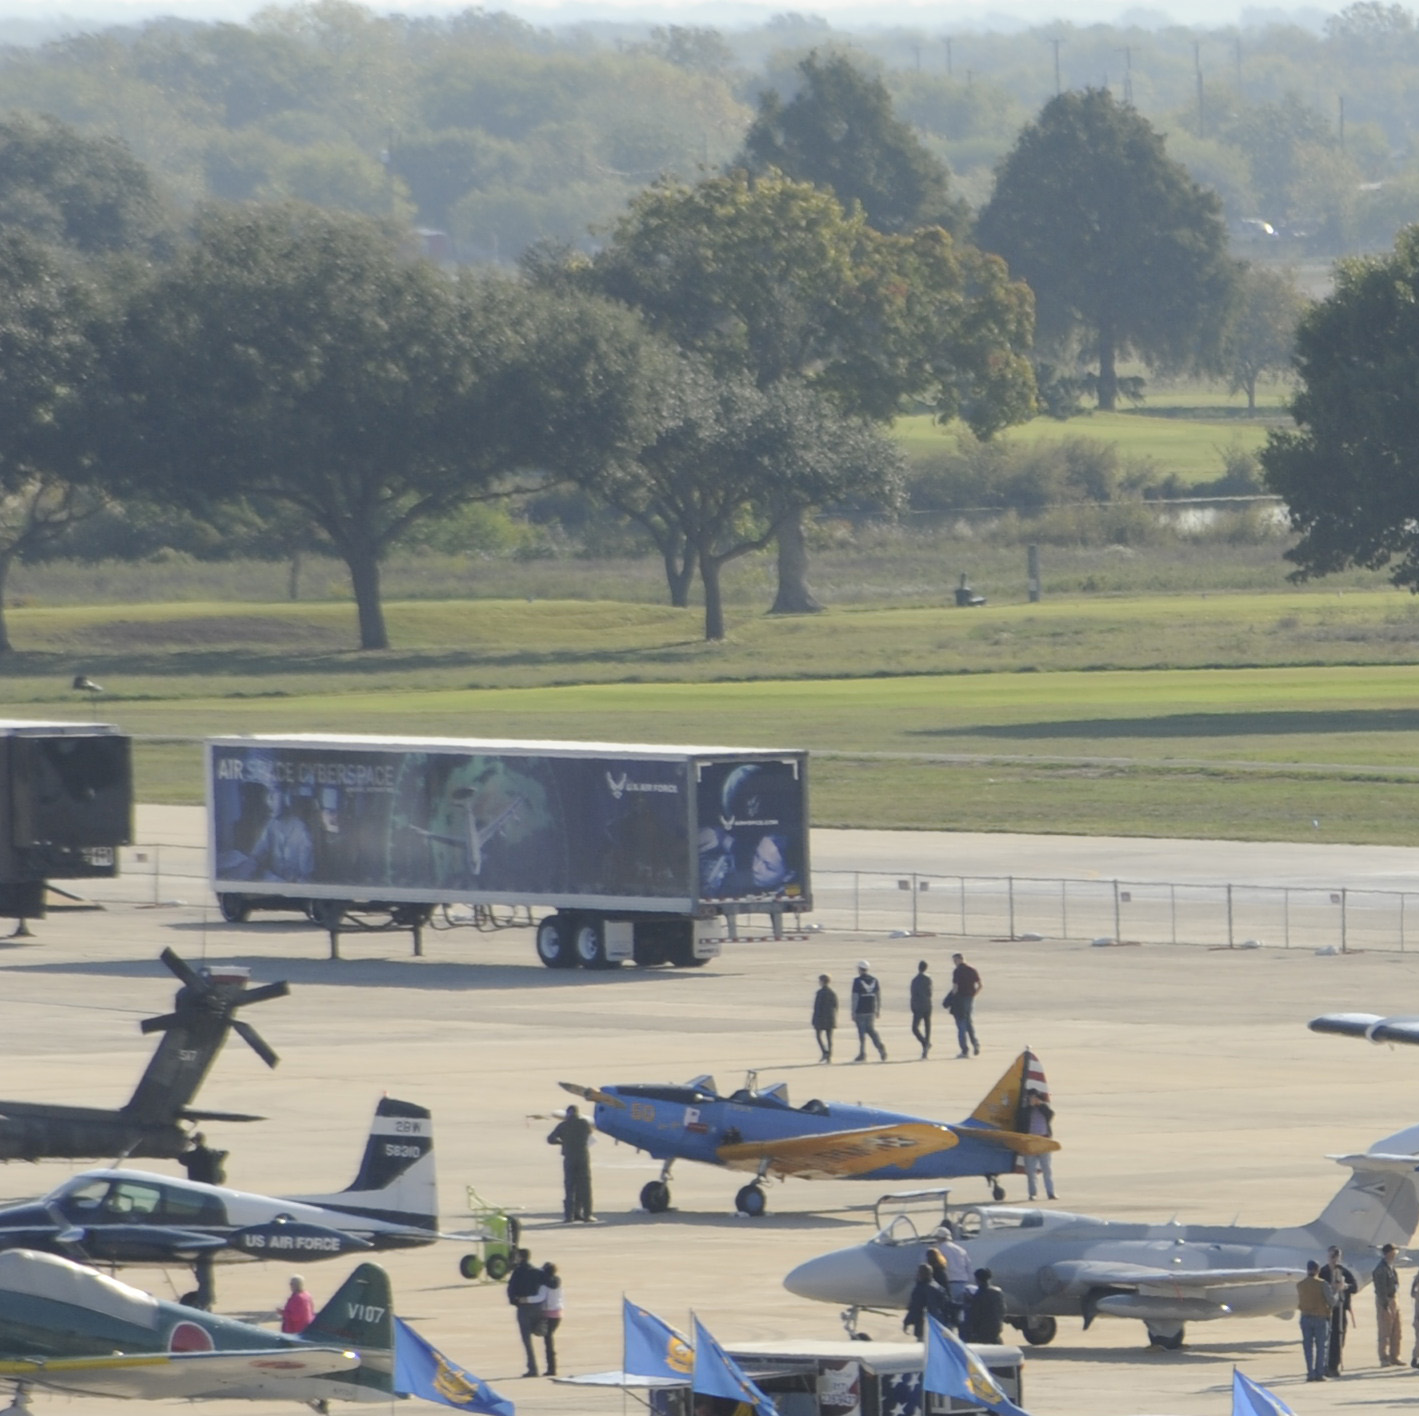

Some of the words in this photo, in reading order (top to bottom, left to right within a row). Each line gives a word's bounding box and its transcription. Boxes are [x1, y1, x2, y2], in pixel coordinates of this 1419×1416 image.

[217, 758, 243, 780] AIR
[245, 1234, 265, 1248] US
[269, 1235, 293, 1249] AIR
[296, 1236, 340, 1251] FORCE
[348, 1303, 385, 1323] V107
